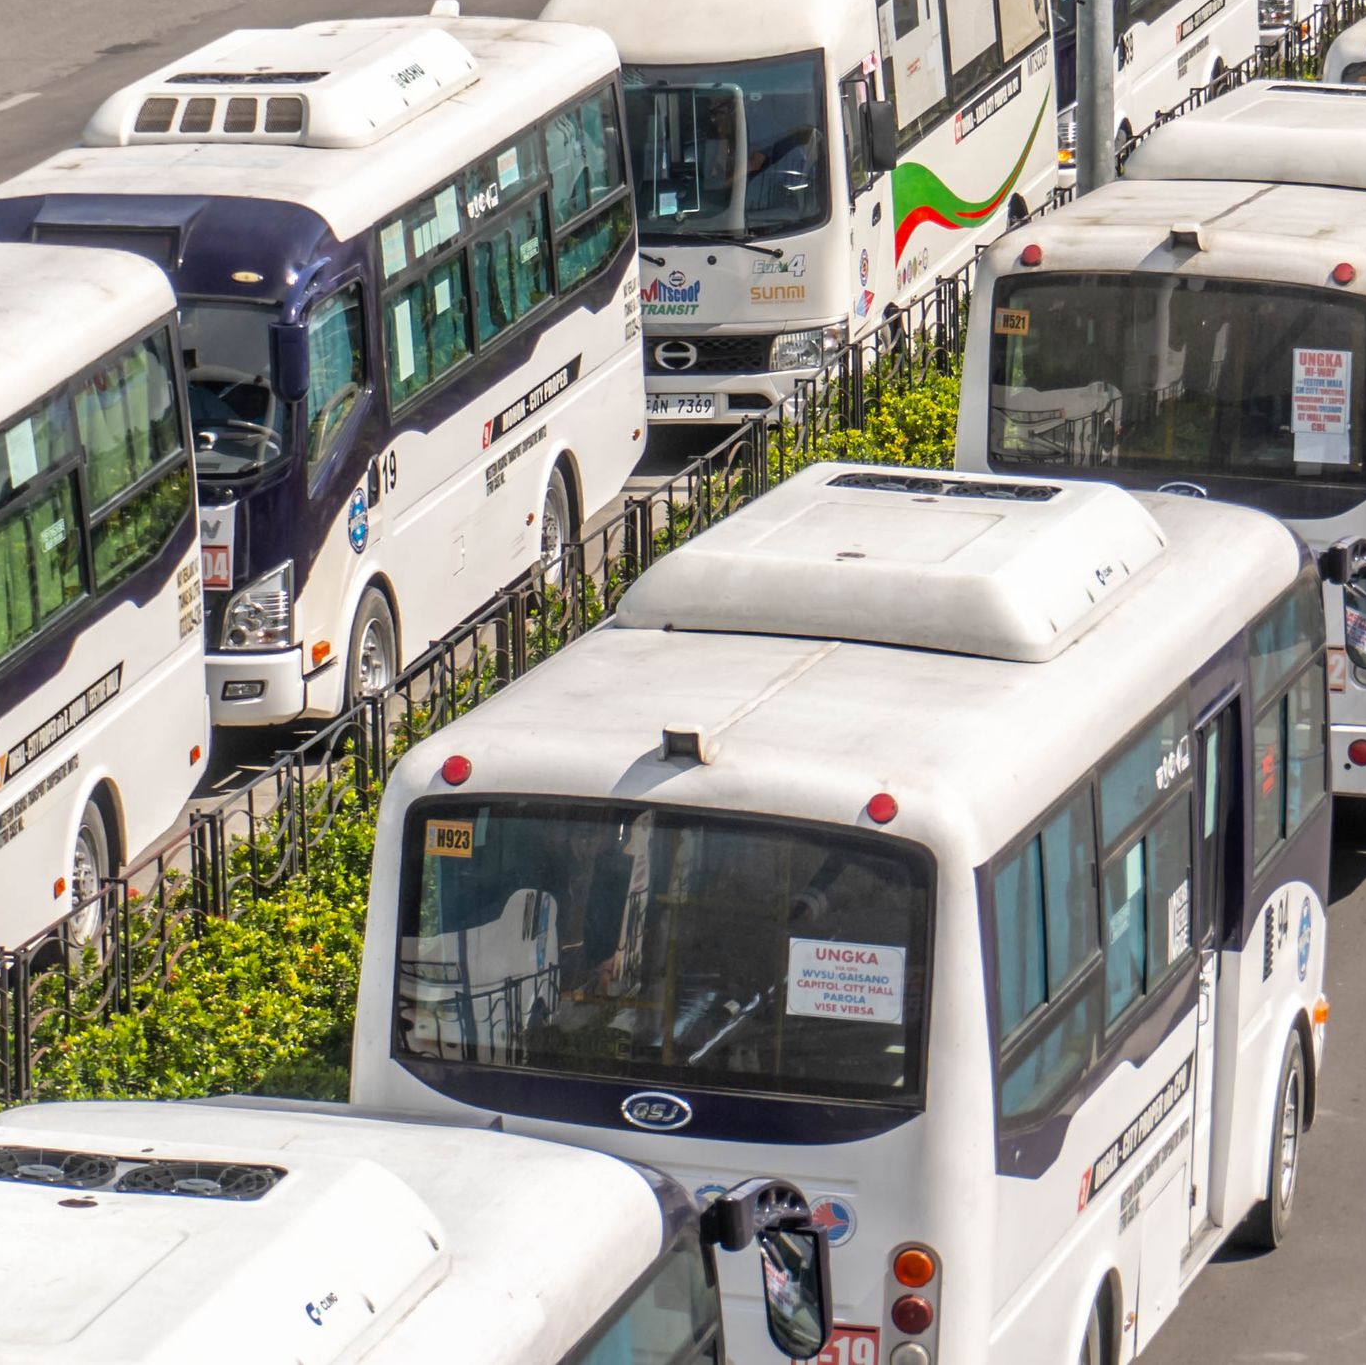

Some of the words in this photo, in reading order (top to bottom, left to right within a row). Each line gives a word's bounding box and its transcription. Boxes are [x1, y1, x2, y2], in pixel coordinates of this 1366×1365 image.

[397, 63, 425, 84] QISHU
[750, 285, 805, 300] SUNMI
[641, 303, 700, 315] TRANSIT
[1299, 352, 1343, 368] UNGKA
[529, 386, 544, 411] CITY
[544, 368, 568, 401] PROPER
[677, 398, 712, 414] 7369
[383, 450, 397, 494] 19
[437, 828, 470, 850] H923
[1277, 891, 1289, 950] 94
[815, 947, 879, 966] UNGKA
[802, 969, 836, 980] WVSU
[838, 972, 890, 985] GAISANO
[796, 979, 840, 991] CAPITOL
[843, 983, 864, 993] CITY
[868, 986, 894, 996] HALL
[823, 992, 866, 1004] PAROLA
[814, 1001, 837, 1013] VISE
[840, 1004, 875, 1016] VERSA
[1094, 1143, 1119, 1190] UNGKA
[1122, 1121, 1139, 1161] CITY
[1138, 1093, 1164, 1143] PROPER
[1173, 1064, 1188, 1102] CPU
